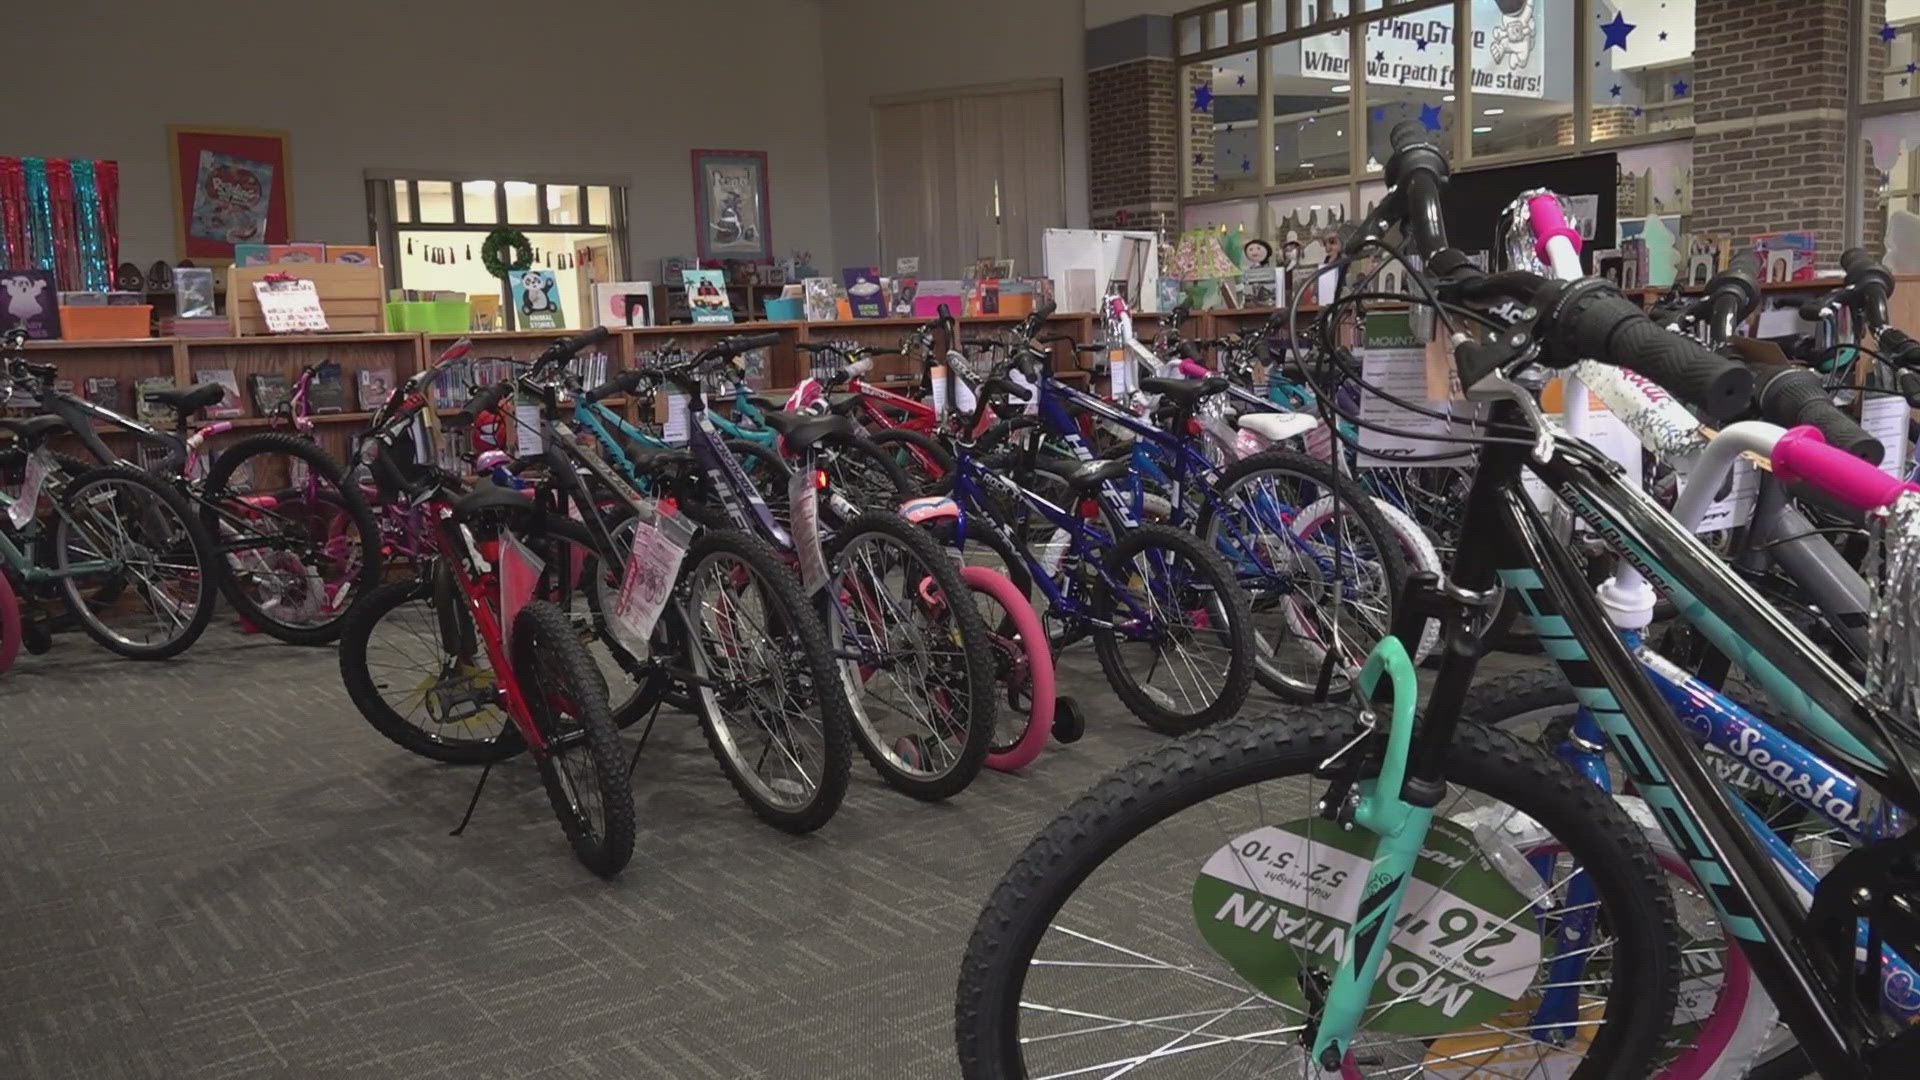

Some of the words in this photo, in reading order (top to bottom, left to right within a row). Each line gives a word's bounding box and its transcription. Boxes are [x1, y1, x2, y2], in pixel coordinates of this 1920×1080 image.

[1427, 20, 1485, 49] Gre
[1367, 60, 1389, 78] we
[1393, 63, 1438, 83] reach
[1471, 68, 1493, 88] the
[1496, 72, 1542, 92] stars!
[697, 315, 729, 323] ADVENTURE
[1560, 481, 1602, 529] Trail
[1601, 527, 1675, 594] Runner
[1263, 869, 1302, 891] Height
[1214, 892, 1474, 1018] MONTAIN
[1428, 948, 1453, 969] Size
[1450, 959, 1486, 982] Wheel
